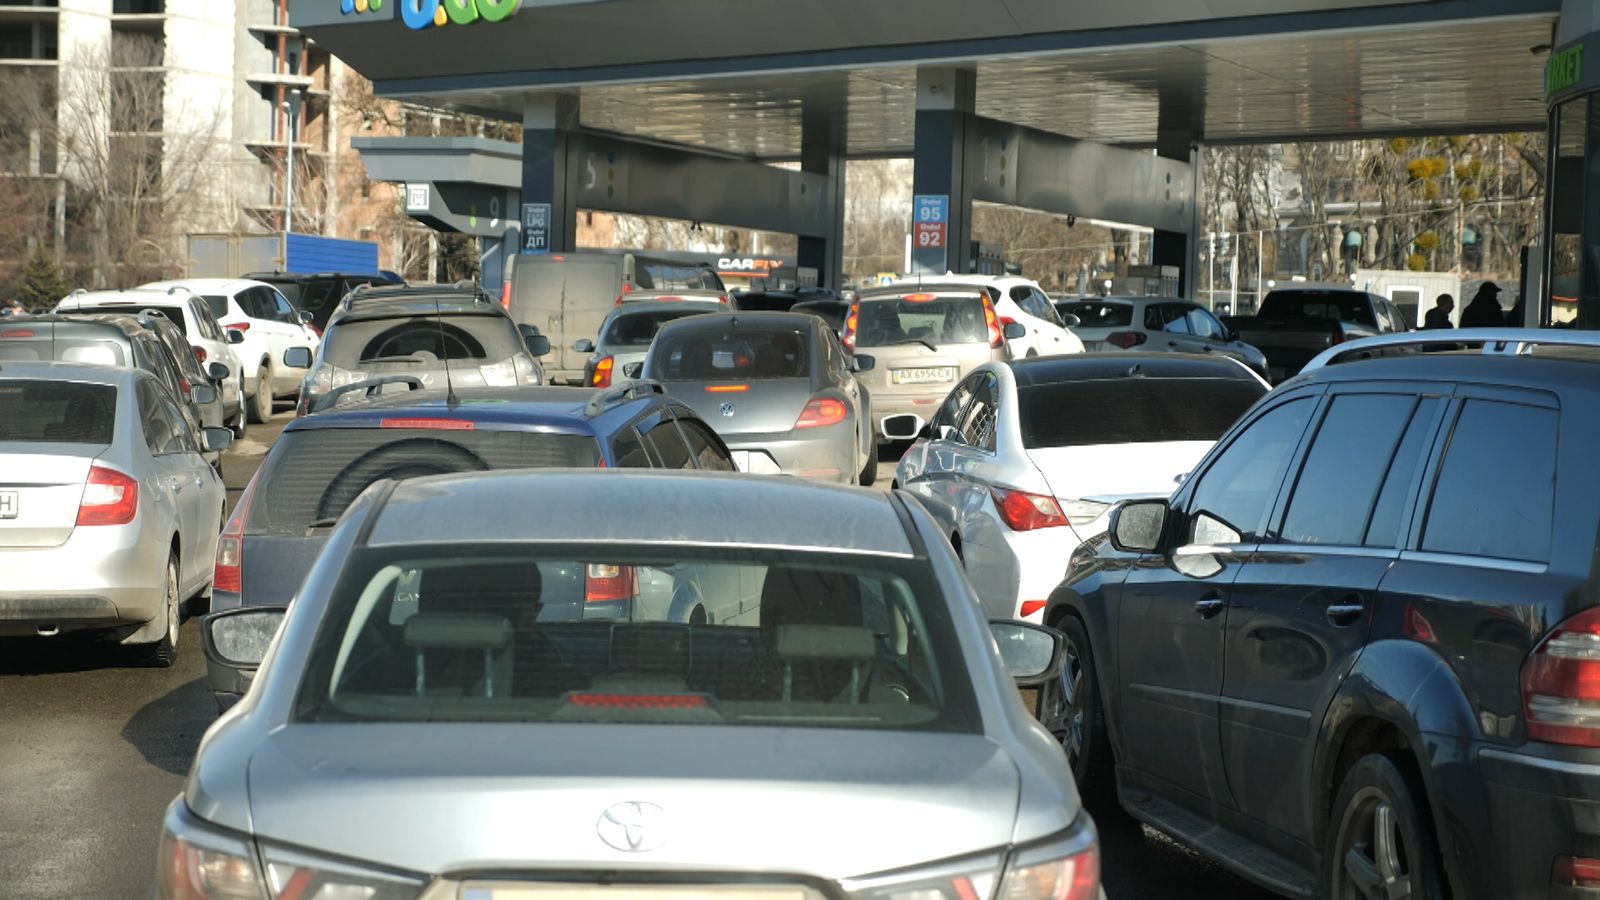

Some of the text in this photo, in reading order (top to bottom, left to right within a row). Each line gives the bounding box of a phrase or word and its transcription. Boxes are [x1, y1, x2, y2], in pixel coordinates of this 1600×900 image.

[920, 206, 941, 221] 95
[526, 236, 545, 248] ДП
[919, 231, 940, 247] 92
